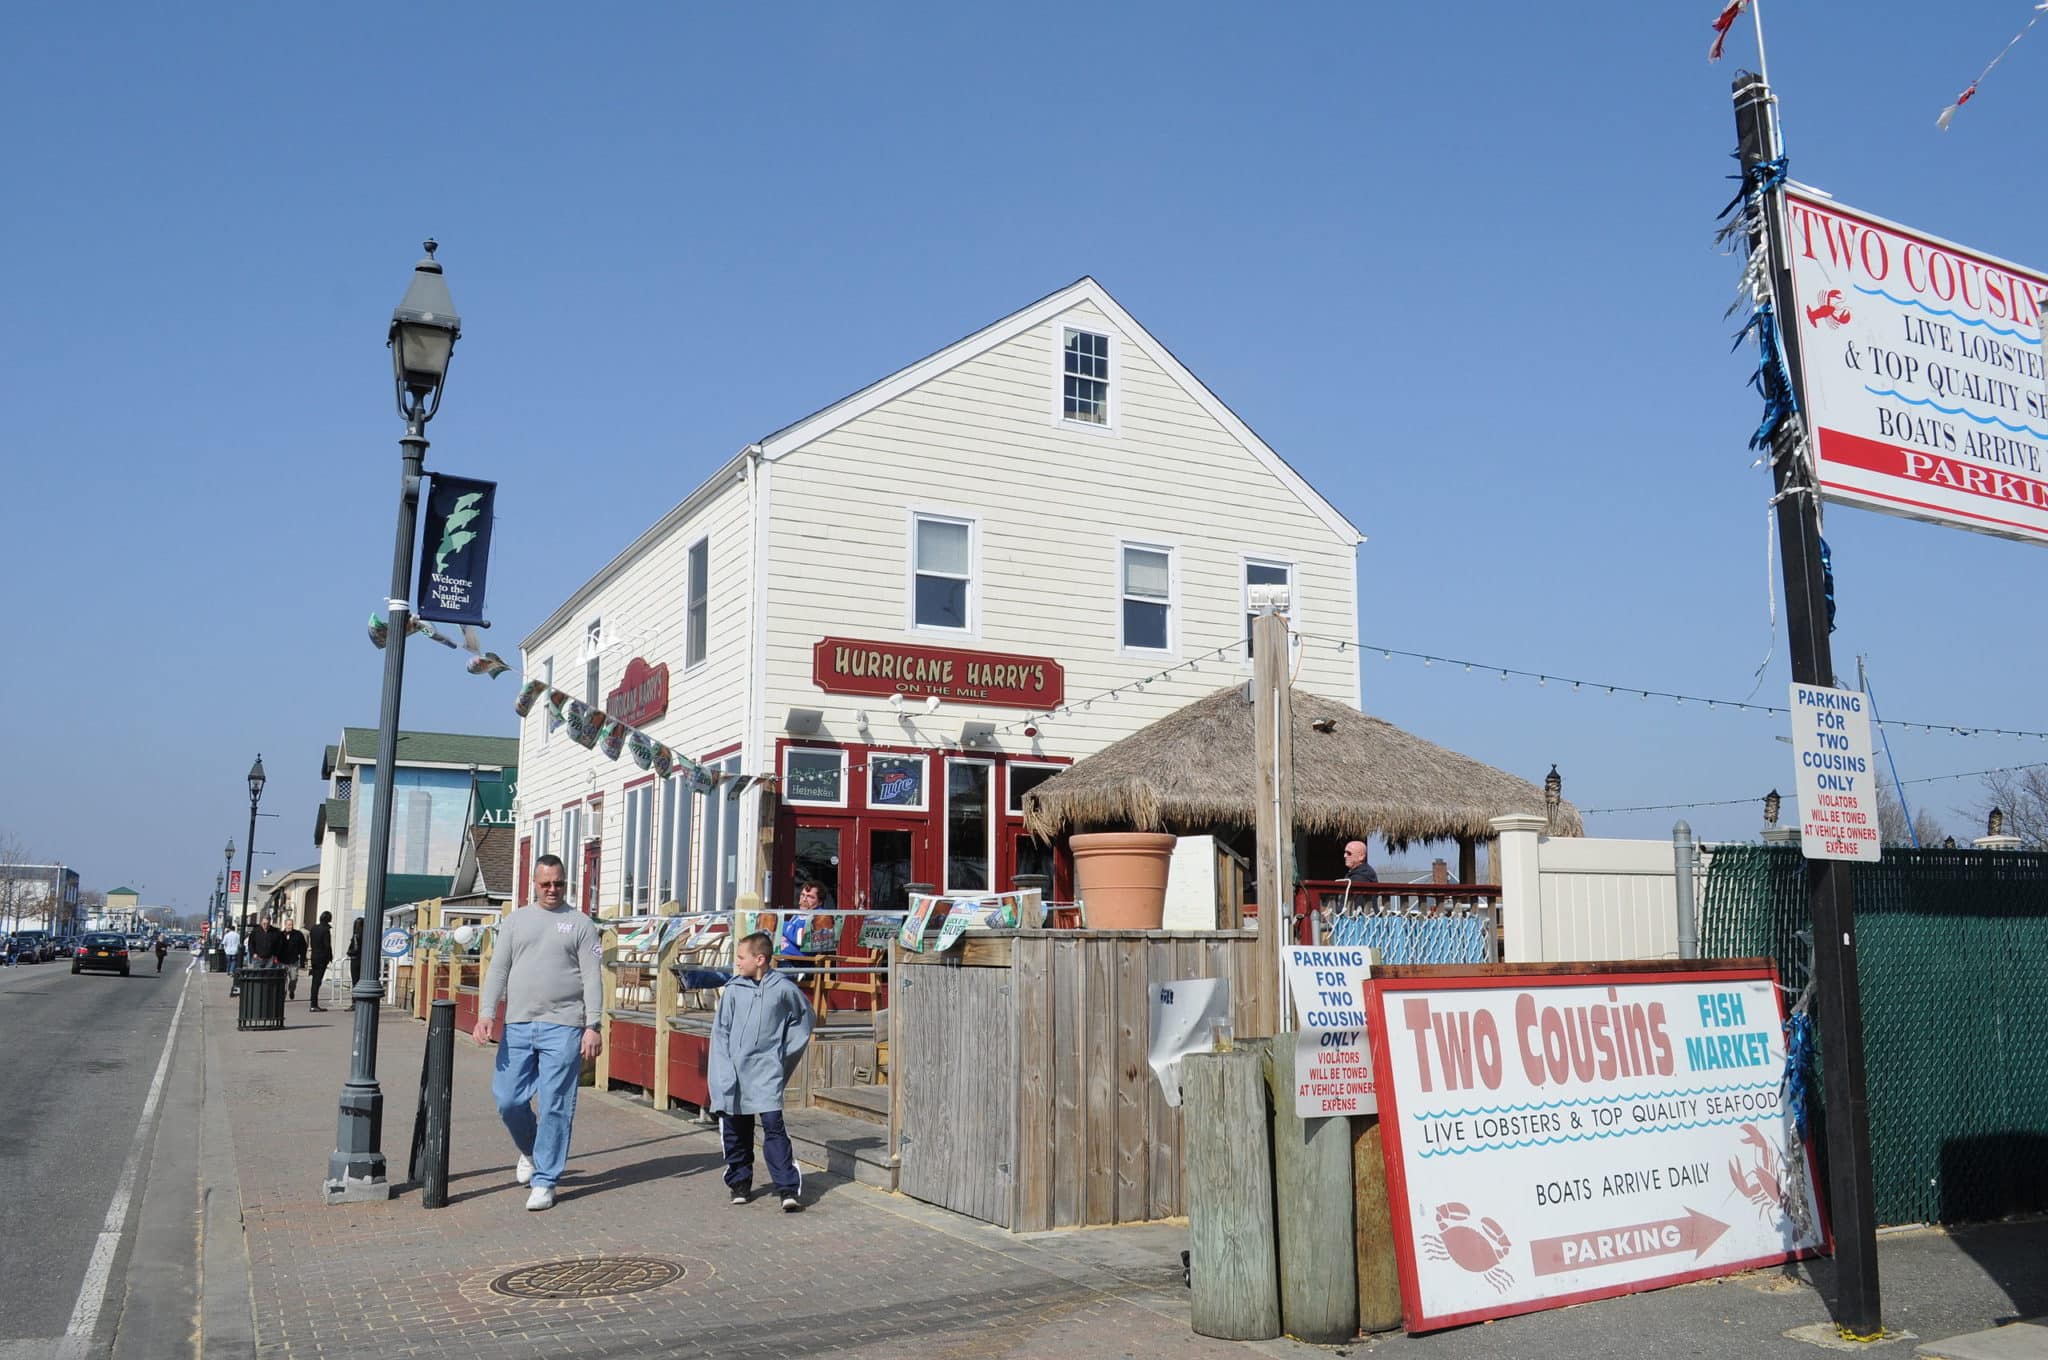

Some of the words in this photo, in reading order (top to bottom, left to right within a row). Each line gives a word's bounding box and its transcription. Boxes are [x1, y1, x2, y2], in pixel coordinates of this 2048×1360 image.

[1793, 207, 1888, 281] TWO
[1903, 243, 2048, 327] COUSIN
[1904, 315, 1953, 352] LIVE
[1960, 331, 2045, 381] LOBSTE
[1845, 340, 1862, 371] &
[1868, 346, 1918, 383] TOP
[1928, 362, 2018, 412] QUALITY
[1877, 407, 1956, 452] BOATS
[1964, 430, 2041, 473] ARRIVE
[432, 573, 472, 588] Welcome
[432, 590, 470, 604] Nautical
[438, 584, 448, 592] to
[450, 584, 465, 594] the
[440, 599, 461, 610] Mile
[834, 646, 953, 684] HURRICANE
[967, 662, 1044, 692] HARRY'S
[896, 683, 920, 693] ON
[925, 686, 951, 695] THE
[956, 688, 989, 698] MILE
[1799, 689, 1861, 712] PARKING
[1817, 712, 1845, 730] FOR
[1816, 733, 1849, 750] TWO
[1803, 752, 1866, 773] COUSINS
[1817, 774, 1854, 791] ONLY
[792, 785, 834, 798] Heineken
[1818, 794, 1858, 808] VIOLATORS
[1811, 809, 1829, 822] WILL
[1830, 811, 1840, 823] BE
[1841, 811, 1866, 824] TOWED
[1804, 824, 1813, 836] AT
[1814, 825, 1845, 839] VEHICLE
[1846, 827, 1877, 841] OWNERS
[1825, 841, 1859, 855] EXPENSE
[1293, 951, 1363, 966] PARKING
[1316, 971, 1347, 987] FOR
[1319, 991, 1353, 1007] TWO
[1697, 993, 1746, 1028] FISH
[1320, 1031, 1360, 1047] ONLY
[1317, 1052, 1360, 1064] VIOLATORS
[1685, 1032, 1771, 1072] MARKET
[1309, 1068, 1328, 1081] WILL
[1330, 1067, 1340, 1080] BE
[1342, 1067, 1368, 1079] TOWED
[1299, 1084, 1309, 1097] AT
[1311, 1084, 1345, 1096] VEHICLE
[1322, 1098, 1357, 1111] EXPENSE
[1424, 1121, 1464, 1144] LIVE
[1474, 1112, 1562, 1139] LOBSTERS
[1570, 1111, 1583, 1128] &
[1591, 1107, 1623, 1126] TOP
[1632, 1100, 1698, 1123] QUALITY
[1706, 1091, 1779, 1115] SEAFOOD
[1536, 1178, 1592, 1206] BOATS
[1602, 1168, 1661, 1196] ARRIVE
[1669, 1162, 1710, 1189] DAILY
[1562, 1225, 1682, 1265] PARKING
